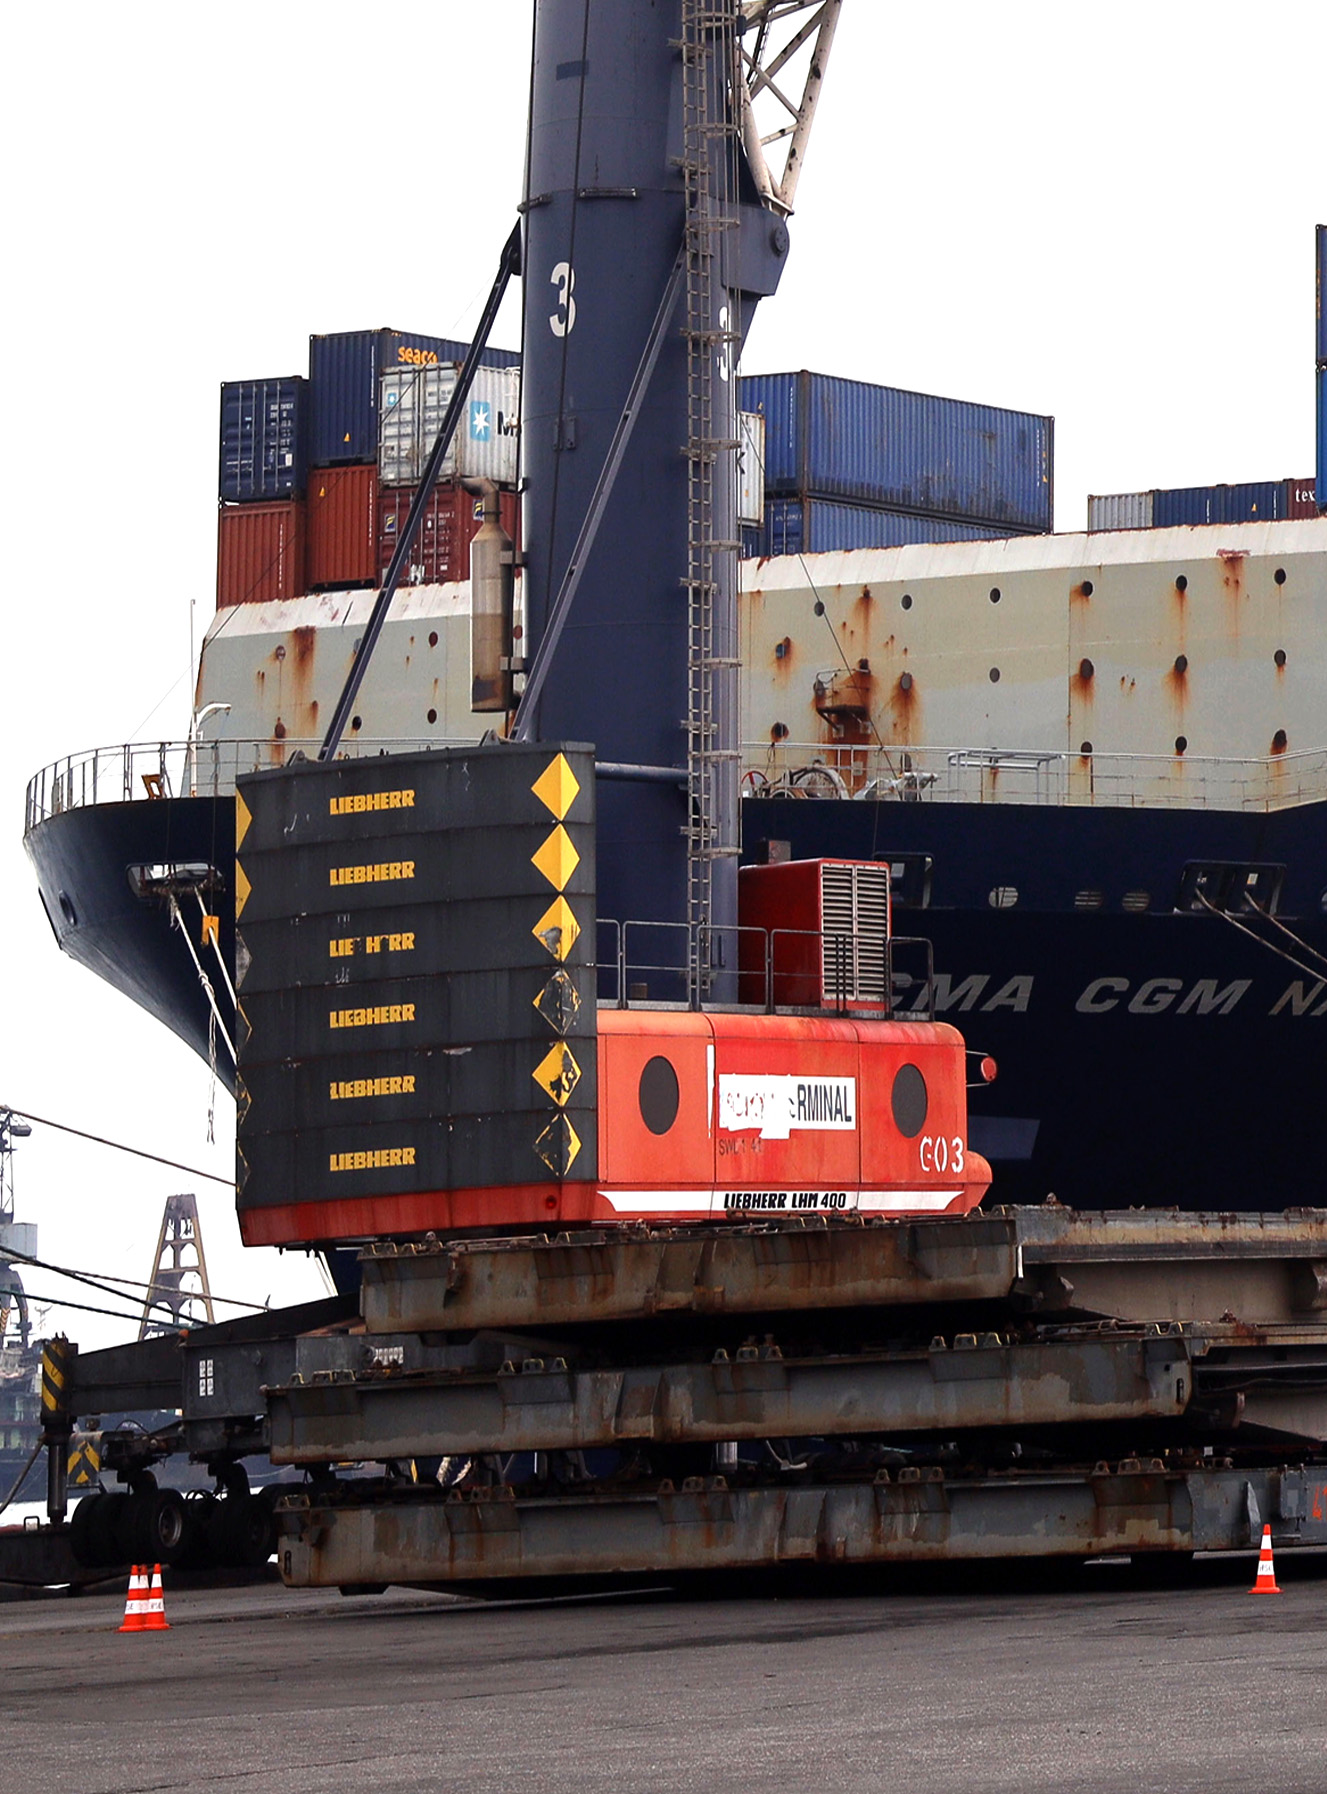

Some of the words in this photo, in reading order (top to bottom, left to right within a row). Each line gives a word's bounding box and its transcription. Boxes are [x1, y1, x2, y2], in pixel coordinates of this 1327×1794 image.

[549, 262, 577, 337] 3
[330, 789, 415, 815] LIEBHERR
[330, 861, 415, 886] LIEBHERR
[330, 932, 415, 957] LIEHRR
[1075, 977, 1252, 1015] CGM
[330, 1003, 415, 1028] LIEBHERR
[330, 1075, 415, 1100] LIEBHERR
[330, 1147, 415, 1172] LIEBHERR
[724, 1193, 787, 1209] LIEBHERR
[791, 1193, 820, 1208] LHM
[820, 1193, 846, 1208] 400
